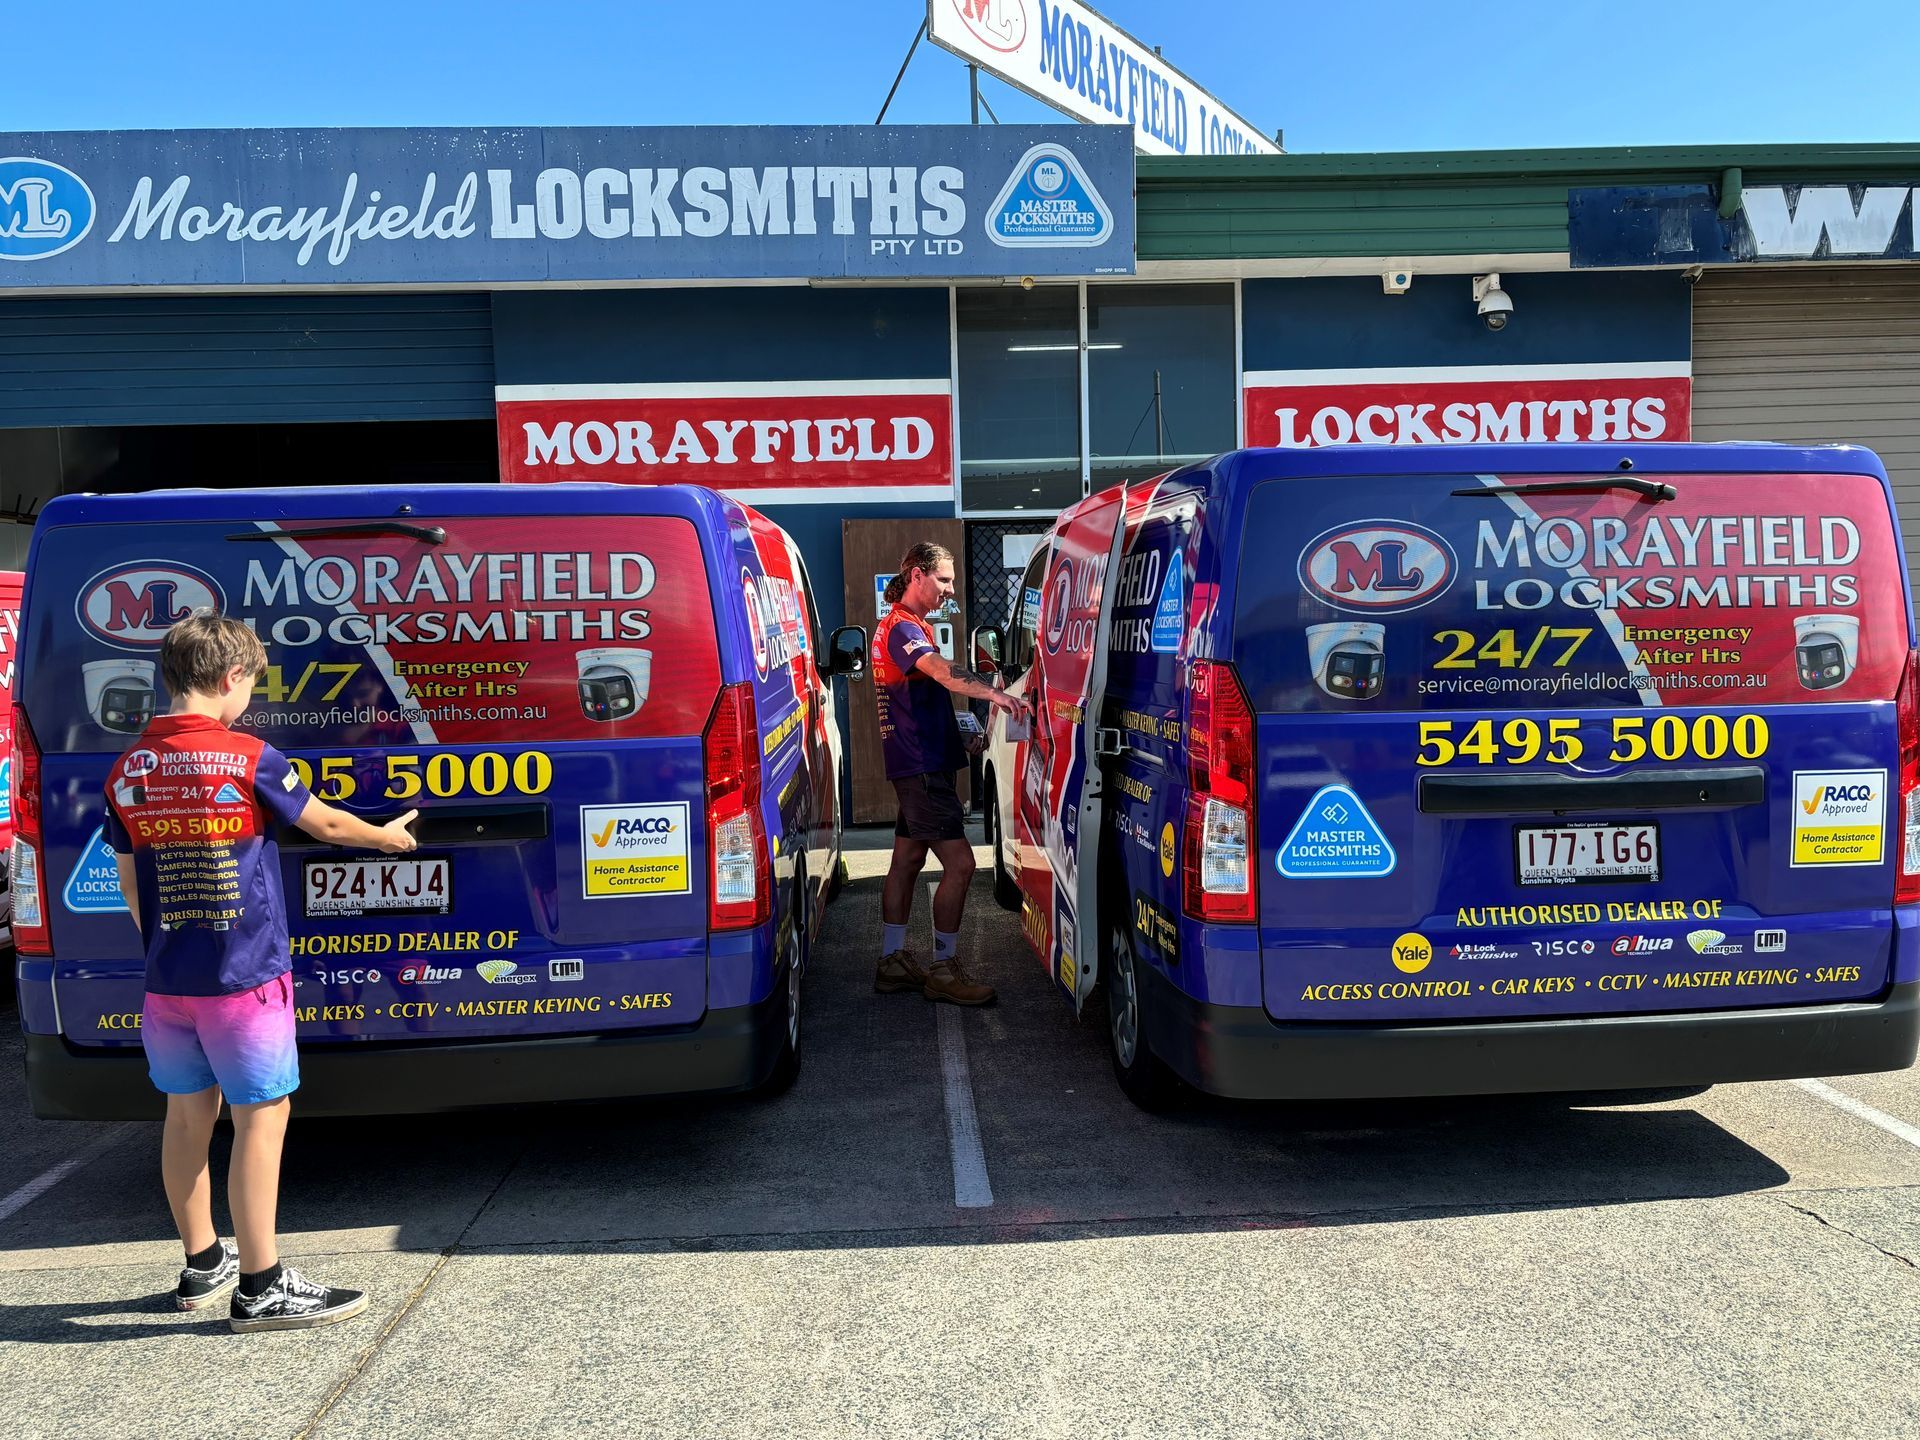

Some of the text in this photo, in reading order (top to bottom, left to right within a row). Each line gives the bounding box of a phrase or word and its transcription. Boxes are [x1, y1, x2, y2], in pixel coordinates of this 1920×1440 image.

[1039, 0, 1187, 154] MORAYFIELD
[1041, 167, 1057, 175] ML
[1020, 199, 1078, 213] MASTER
[107, 165, 966, 266] Morayfield LOCKSMITHS
[1003, 212, 1096, 225] LOCKSMITHS
[1003, 224, 1096, 233] Professional Guarantee
[870, 239, 964, 256] PTY LTD
[1274, 397, 1667, 448] LOCKSMITHS
[522, 416, 935, 466] MORAYFIELD
[1474, 514, 1861, 570] MORAYFIELD
[1330, 540, 1424, 592] ML
[242, 551, 657, 608] MORAYFIELD
[1475, 574, 1861, 611] LOCKSMITHS
[105, 580, 191, 630] ML
[1624, 625, 1752, 646] Emergency
[1432, 625, 1593, 669] 24/7
[1635, 647, 1741, 666] After Hrs
[393, 659, 530, 678] Emergency
[251, 661, 362, 703] 4/7
[405, 680, 518, 699] After Hrs
[1418, 671, 1767, 697] service@morayfieldlocksmiths.com.au
[1163, 719, 1181, 743] SAFES
[1415, 713, 1770, 766] 5495 5000
[162, 751, 248, 767] MORAYFIELD
[162, 763, 246, 778] LOCKSMITHS
[383, 750, 554, 800] 5000
[181, 786, 215, 800] 24/7
[1142, 784, 1153, 804] OF
[1824, 785, 1872, 802] RACQ
[1822, 802, 1868, 817] Approved
[189, 816, 243, 836] 5000
[616, 817, 671, 835] RACQ
[615, 834, 668, 849] Approved
[1306, 830, 1366, 843] MASTER
[1801, 832, 1876, 843] Home Assistance
[161, 851, 184, 860] KEYS
[185, 850, 200, 858] AND
[1291, 844, 1381, 857] LOCKSMITHS
[1813, 845, 1864, 855] Contractor
[89, 867, 118, 879] MAS
[158, 862, 197, 872] CAMERAS
[594, 863, 679, 875] Home Assistance
[1525, 865, 1652, 877] QUEENSLAND SUNSHINE STATE
[181, 872, 198, 880] AND
[608, 876, 666, 886] Contractor
[1521, 876, 1576, 885] Sunshine Toyota
[76, 881, 121, 893] LOCKS
[217, 881, 239, 891] KEYS
[170, 893, 198, 903] SALES
[312, 898, 444, 910] QUEENSLAND SUNSHINE STATE
[306, 908, 363, 917] Sunshine Toyota
[1136, 898, 1155, 938] 24/7
[1456, 899, 1722, 928] AUTHORISED DEALER OF
[289, 930, 519, 955] HORISED DEALER OF
[1474, 943, 1496, 952] Lock
[1702, 944, 1743, 956] energex
[1395, 946, 1429, 961] Yale
[1458, 951, 1518, 960] Exclusive
[493, 973, 537, 985] energex
[1300, 966, 1861, 1001] ACCESS CONTROL CAR KEYS CCTV MASTER KEYING SAFES
[294, 992, 672, 1022] AR KEYS CCTV MASTER KEYING SAFES
[97, 1014, 142, 1029] ACCE
